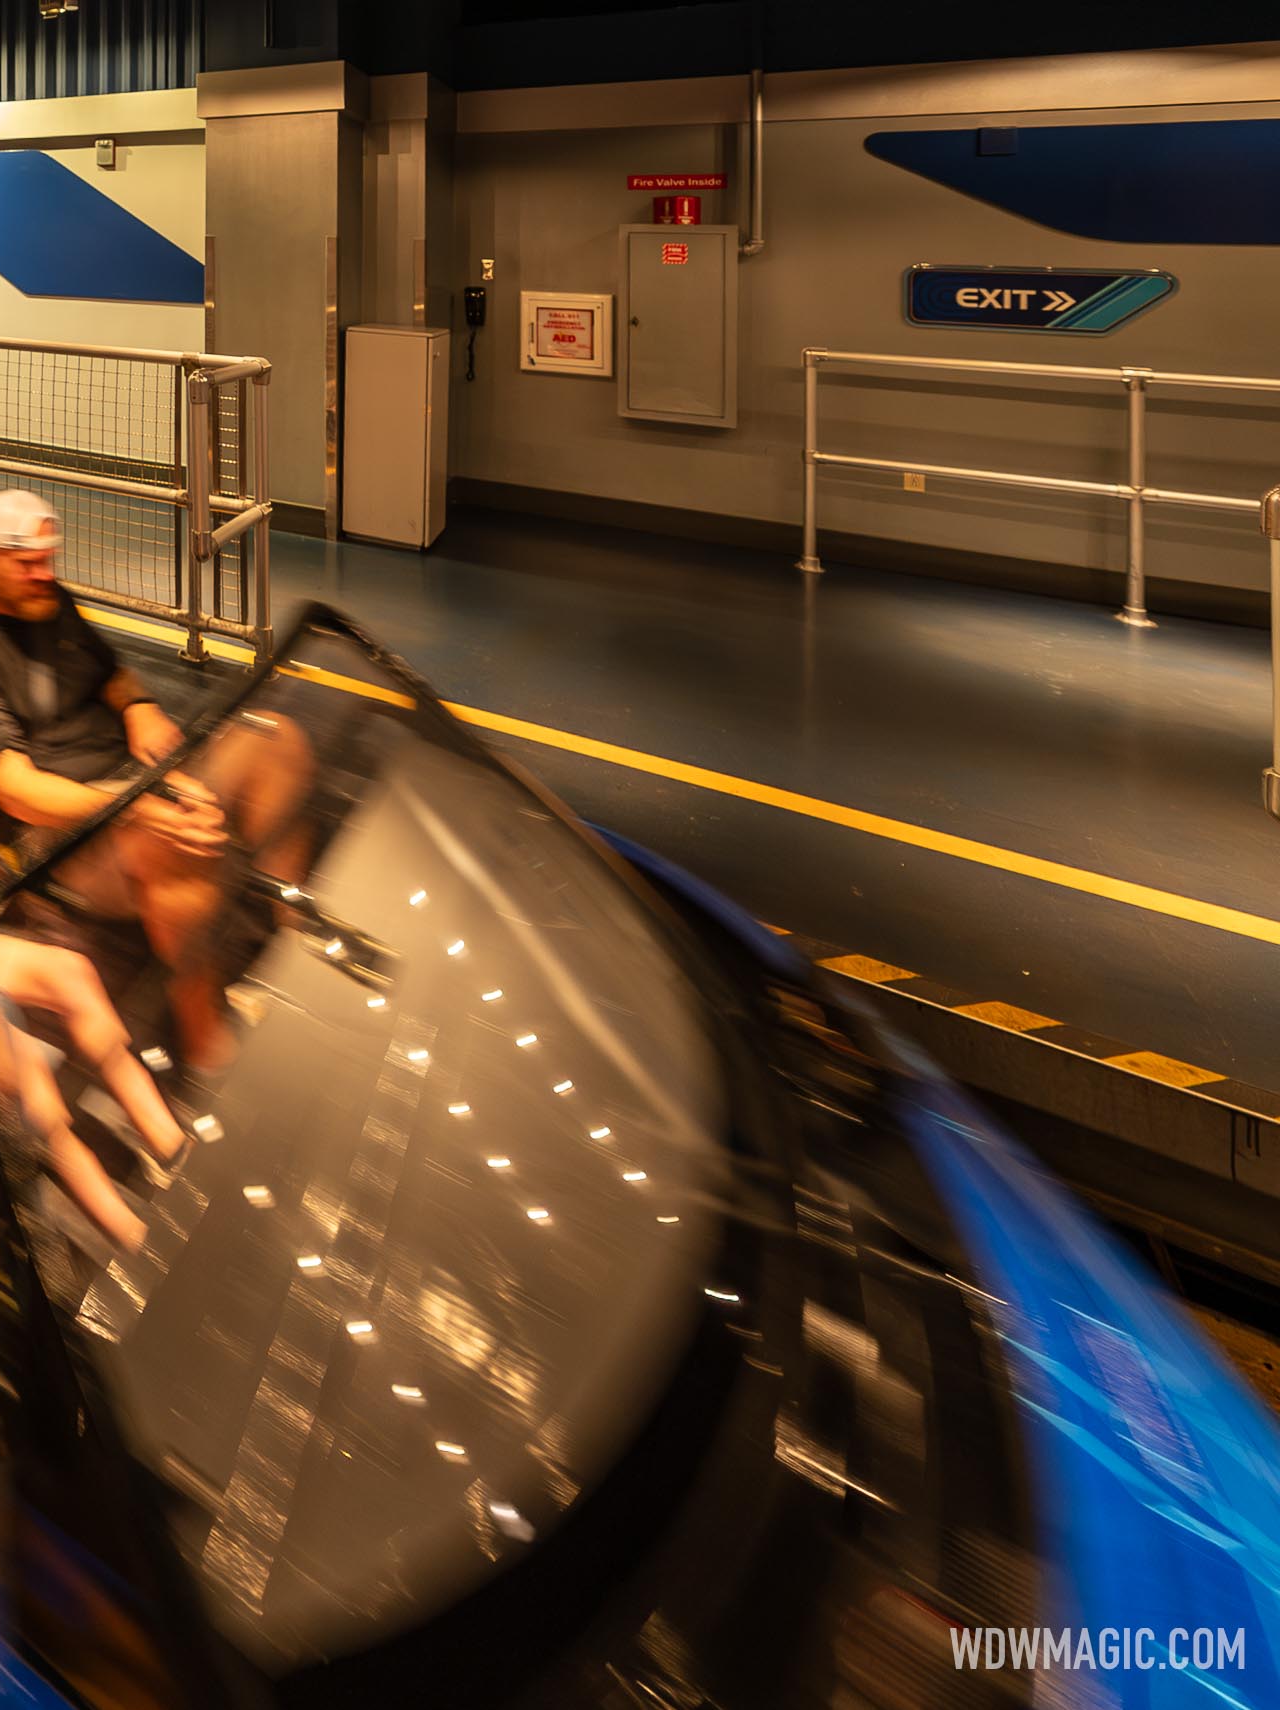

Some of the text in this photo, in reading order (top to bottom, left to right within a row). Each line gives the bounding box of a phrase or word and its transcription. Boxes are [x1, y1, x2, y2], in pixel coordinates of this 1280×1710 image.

[633, 177, 722, 187] Fire Valve Inside
[955, 288, 1037, 310] EXIT
[552, 333, 577, 343] AED
